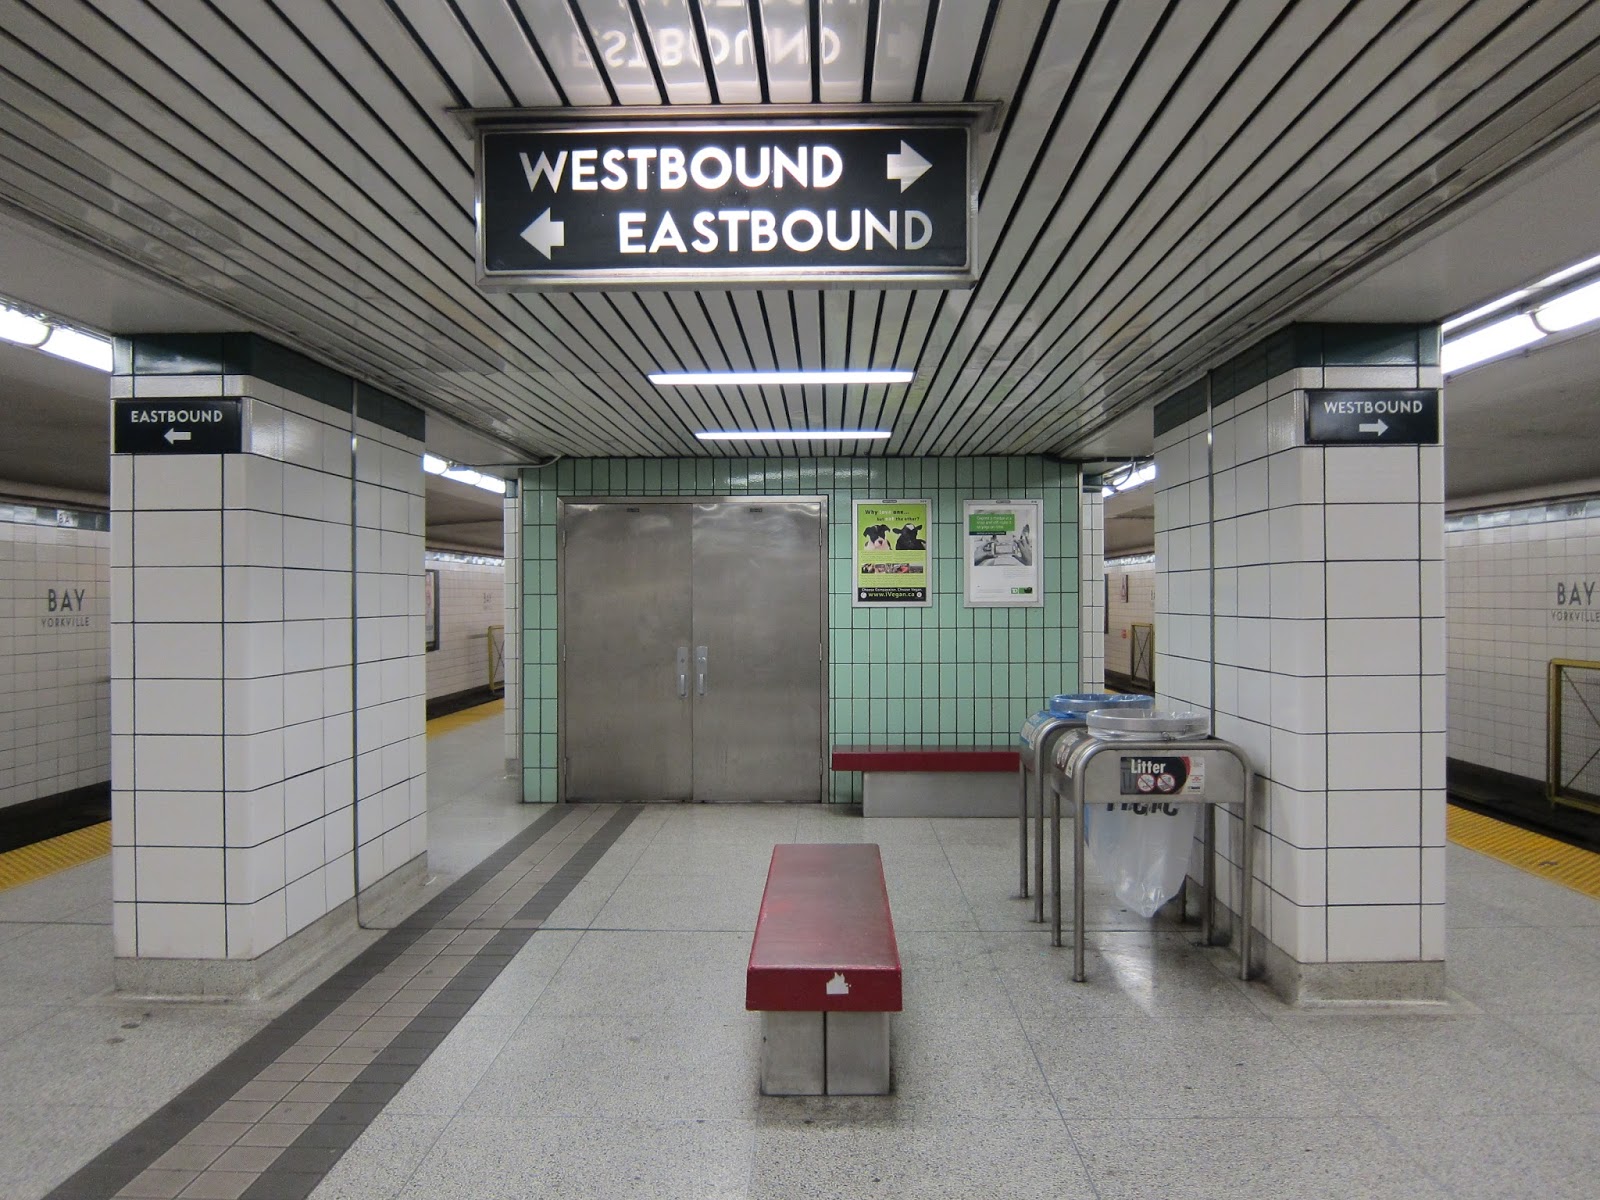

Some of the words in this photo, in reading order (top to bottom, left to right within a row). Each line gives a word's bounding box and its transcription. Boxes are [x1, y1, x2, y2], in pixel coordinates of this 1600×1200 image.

[519, 145, 844, 194] WESTBOUND
[618, 210, 933, 254] EASTBOUND
[1323, 401, 1423, 414] WESTBOUND
[131, 410, 223, 423] EASTBOUND
[48, 589, 85, 612] BAY
[1557, 582, 1596, 606] BAY
[41, 616, 90, 628] YORKVILLE
[1552, 610, 1600, 623] YORKVILLE
[1131, 758, 1166, 774] Litter
